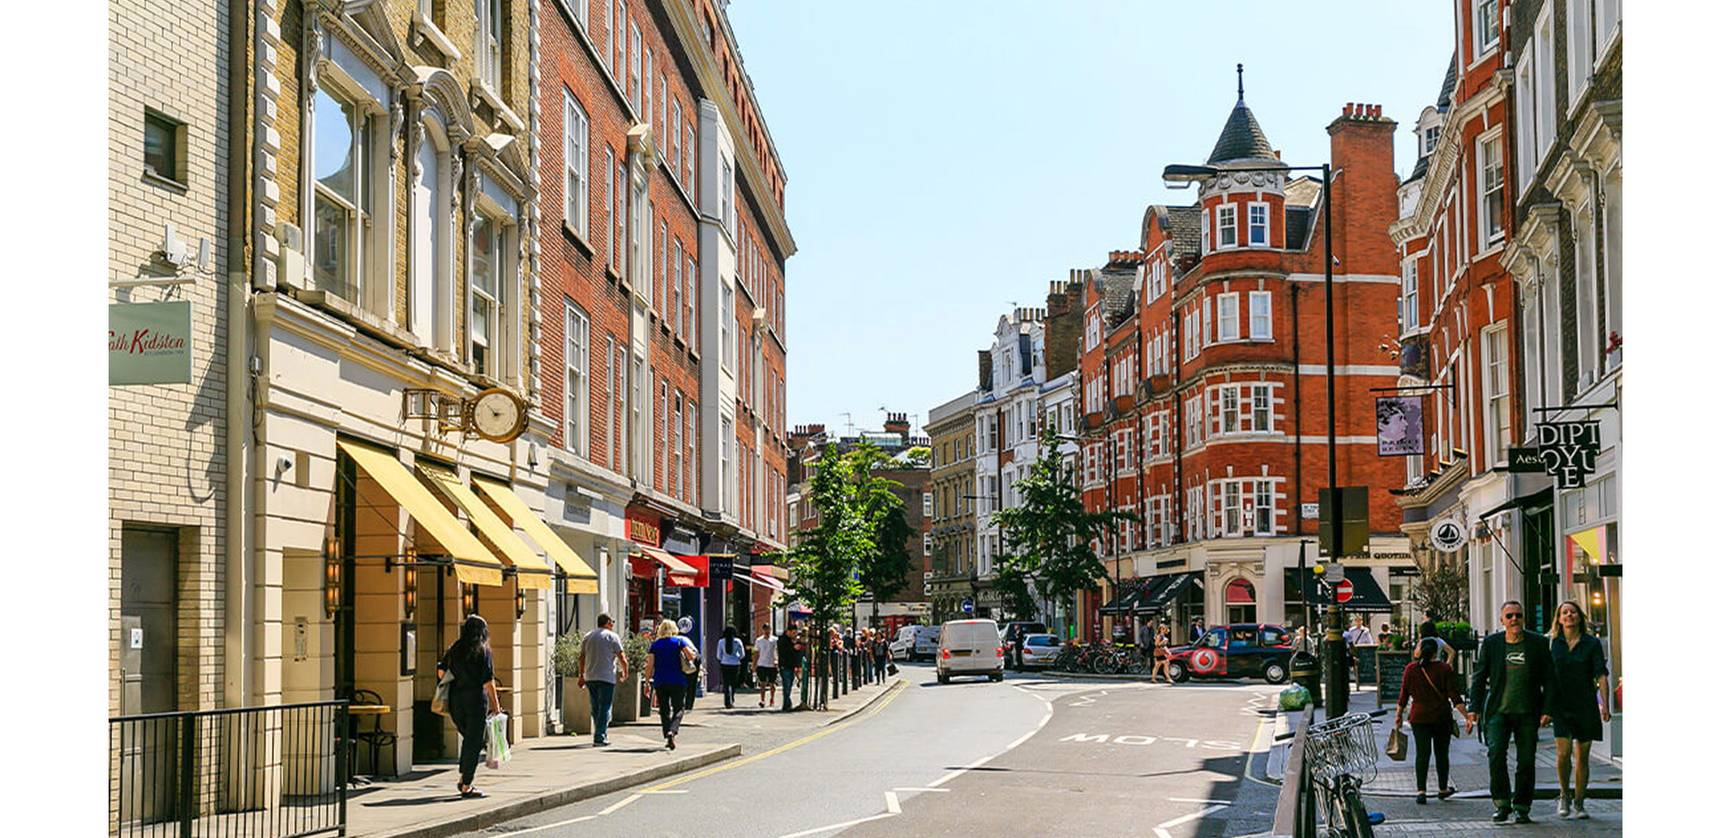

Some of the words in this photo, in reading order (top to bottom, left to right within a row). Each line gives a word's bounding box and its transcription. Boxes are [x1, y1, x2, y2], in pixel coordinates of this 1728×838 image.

[130, 328, 185, 353] Kidston
[1539, 422, 1601, 446] DIPT
[1561, 466, 1580, 488] E
[1058, 733, 1241, 750] SLOW
